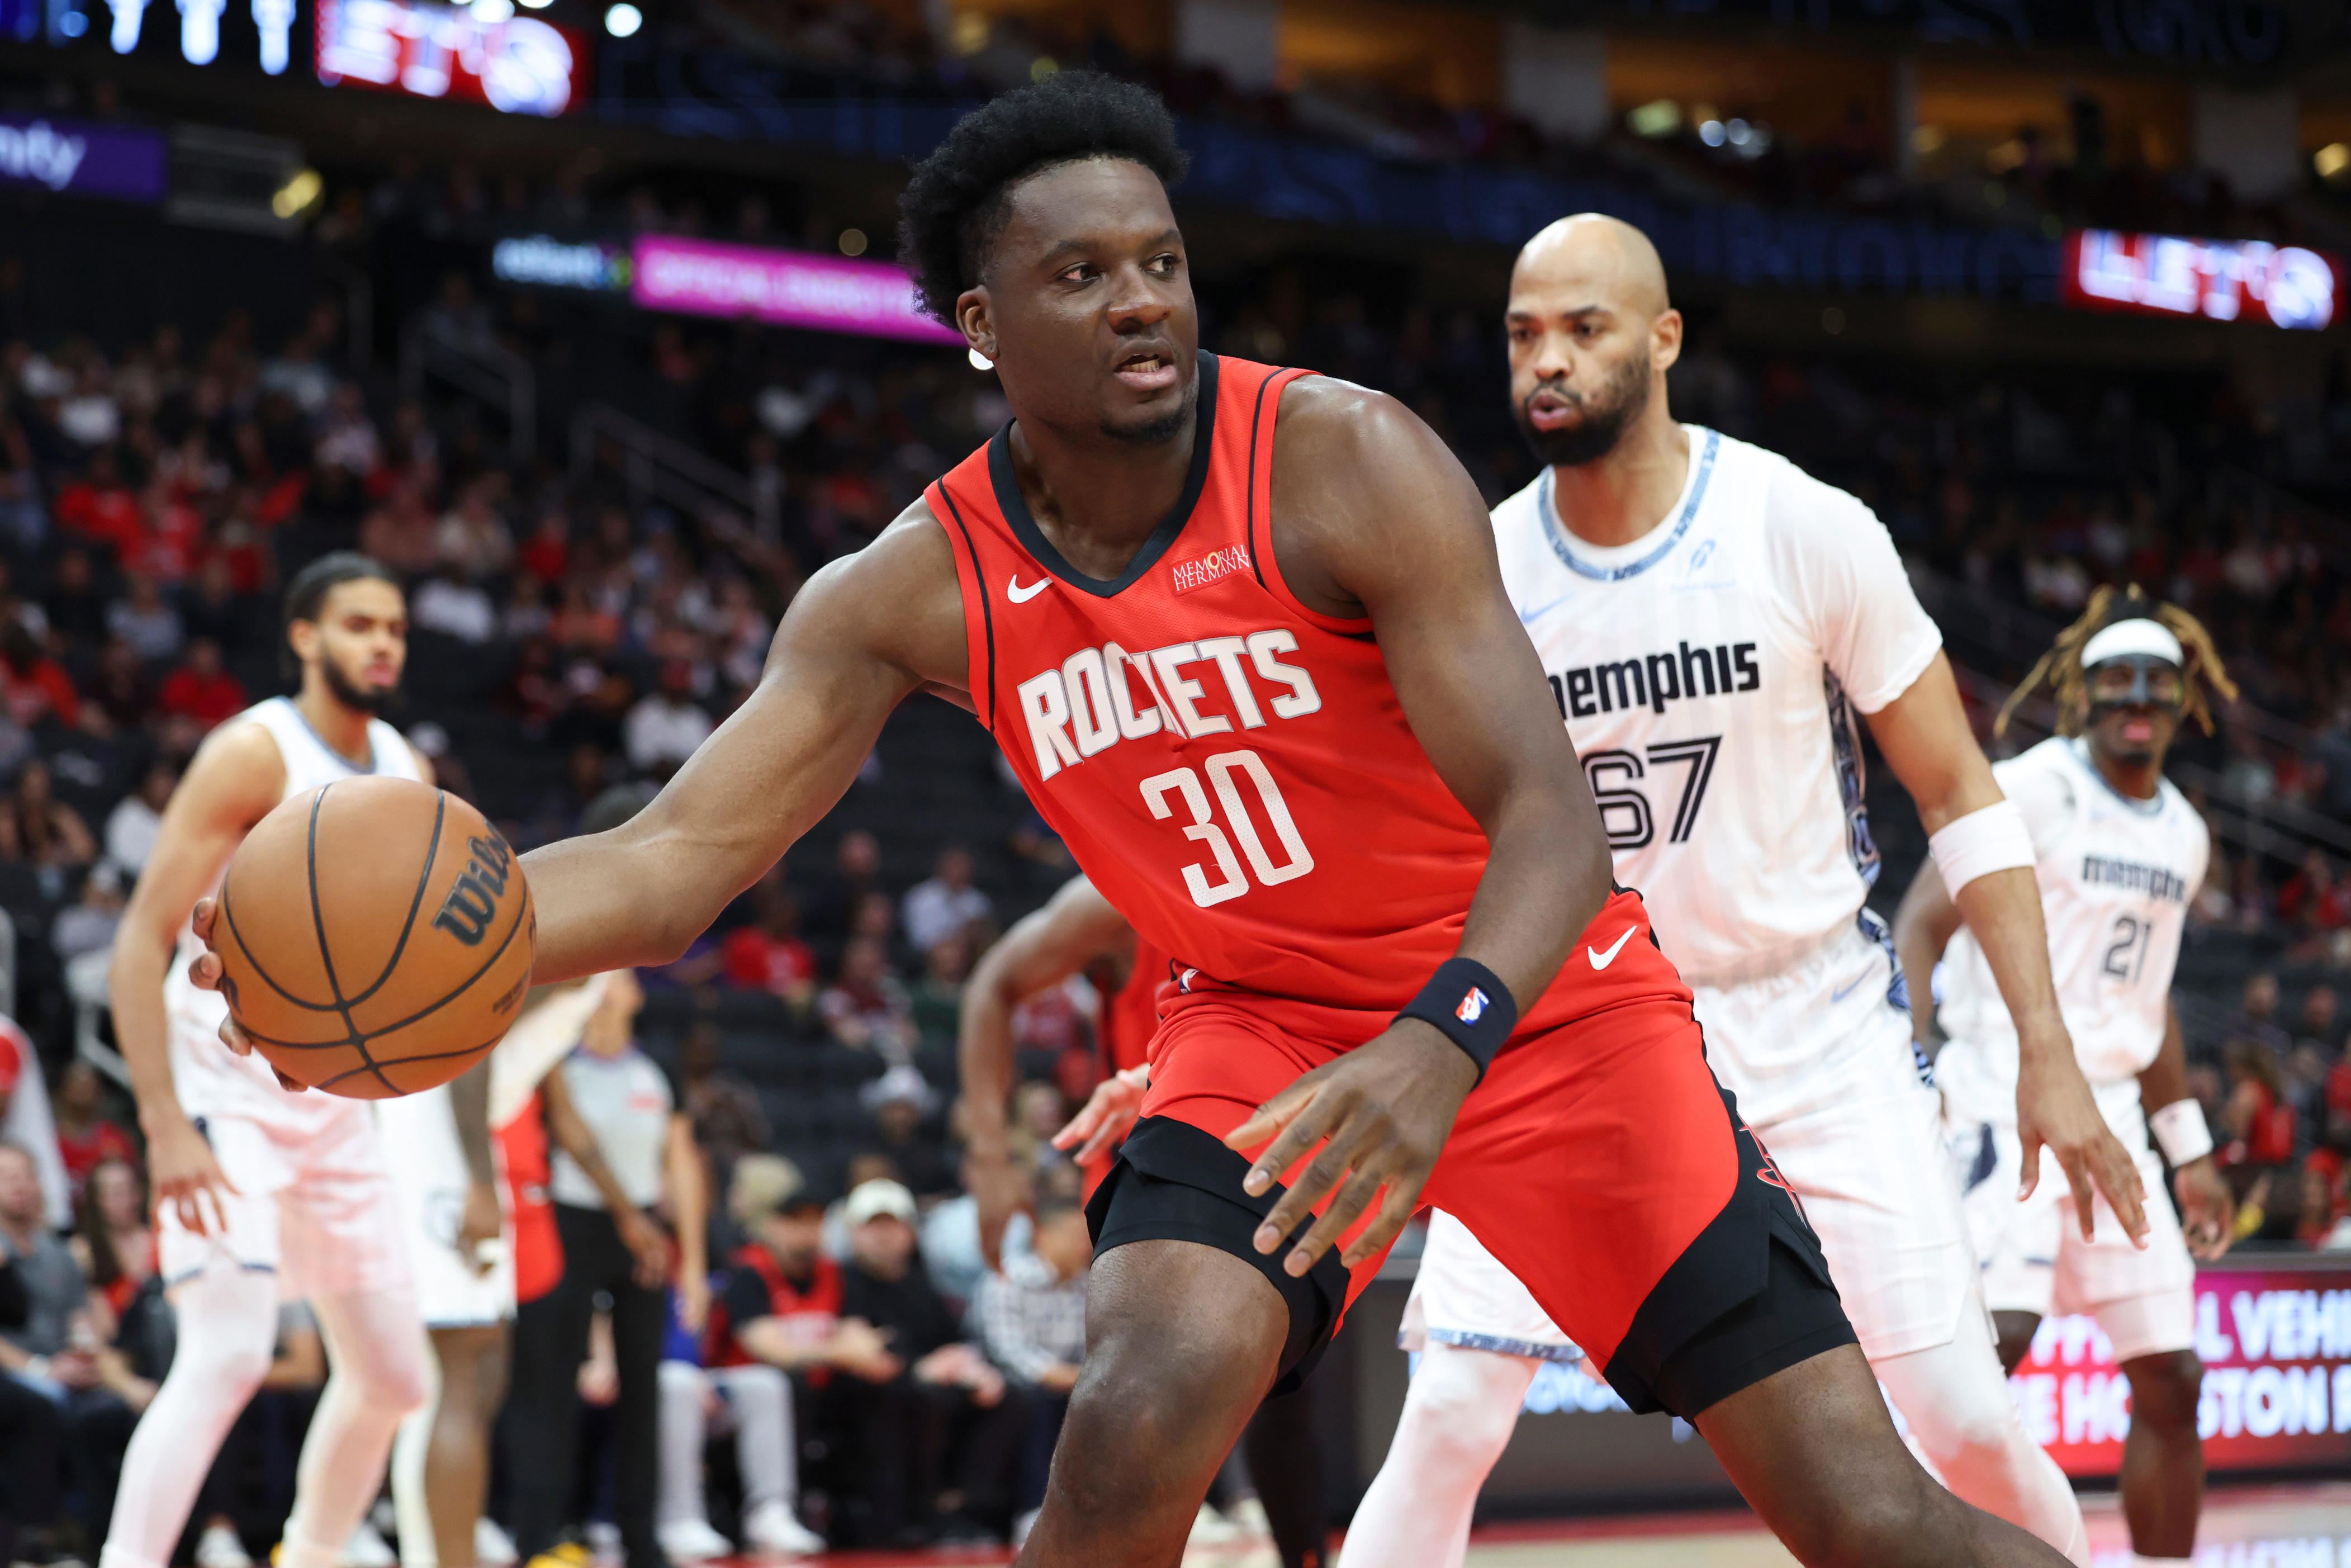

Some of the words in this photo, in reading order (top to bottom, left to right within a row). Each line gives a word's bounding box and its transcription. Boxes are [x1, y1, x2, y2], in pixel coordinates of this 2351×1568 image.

[1173, 544, 1249, 580] MEMORIAL
[1174, 556, 1250, 591] HERMANN
[1581, 735, 1722, 849] 67
[1139, 749, 1315, 908] 30
[2103, 914, 2151, 982] 21
